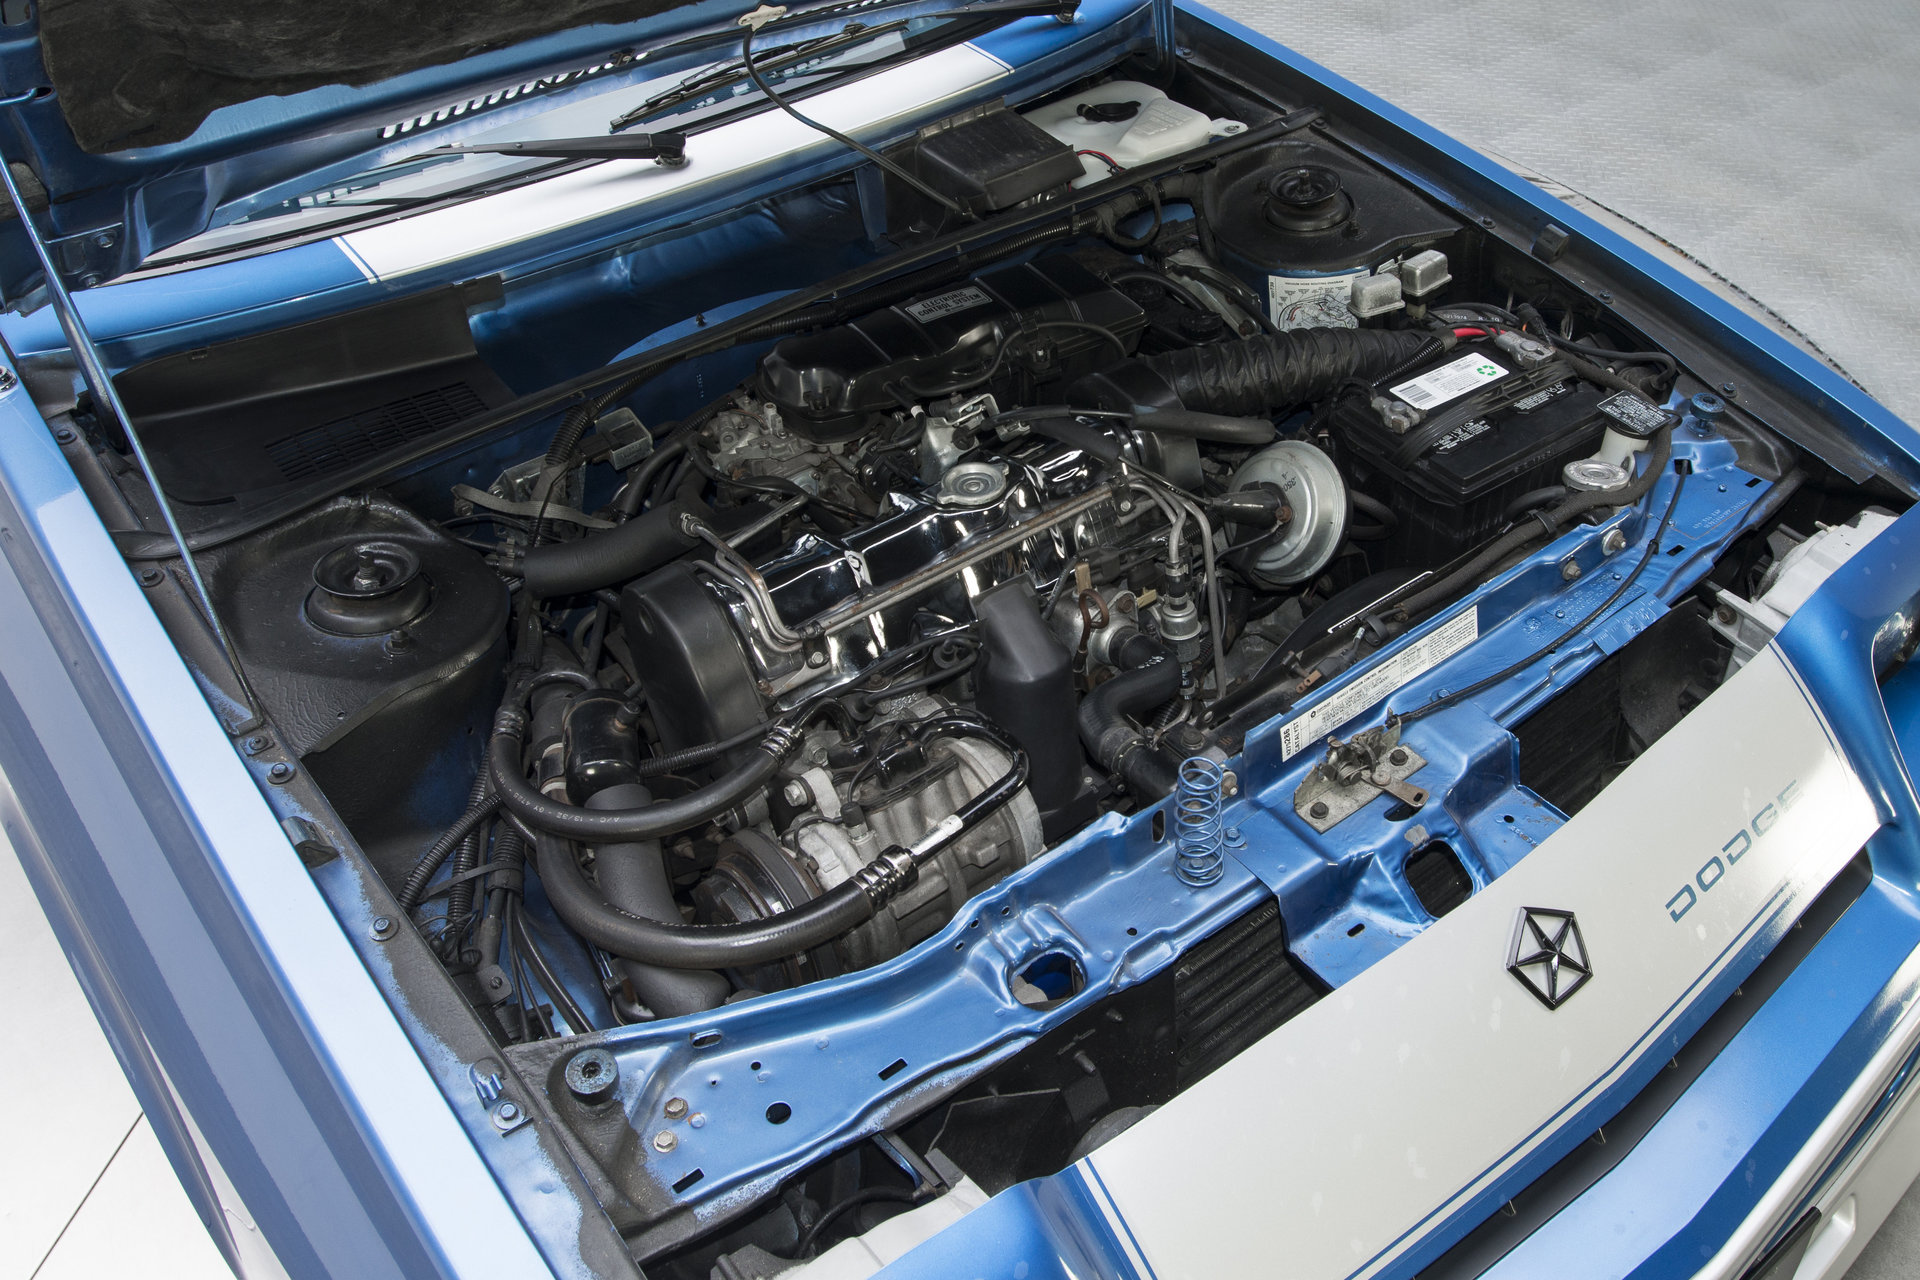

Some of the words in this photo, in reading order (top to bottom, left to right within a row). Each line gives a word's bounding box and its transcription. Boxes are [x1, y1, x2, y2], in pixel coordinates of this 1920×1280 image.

[918, 303, 952, 317] CONTROL
[953, 293, 980, 305] SYSTEM
[921, 291, 967, 309] ELECTRONIC
[1664, 779, 1801, 923] DODGE
